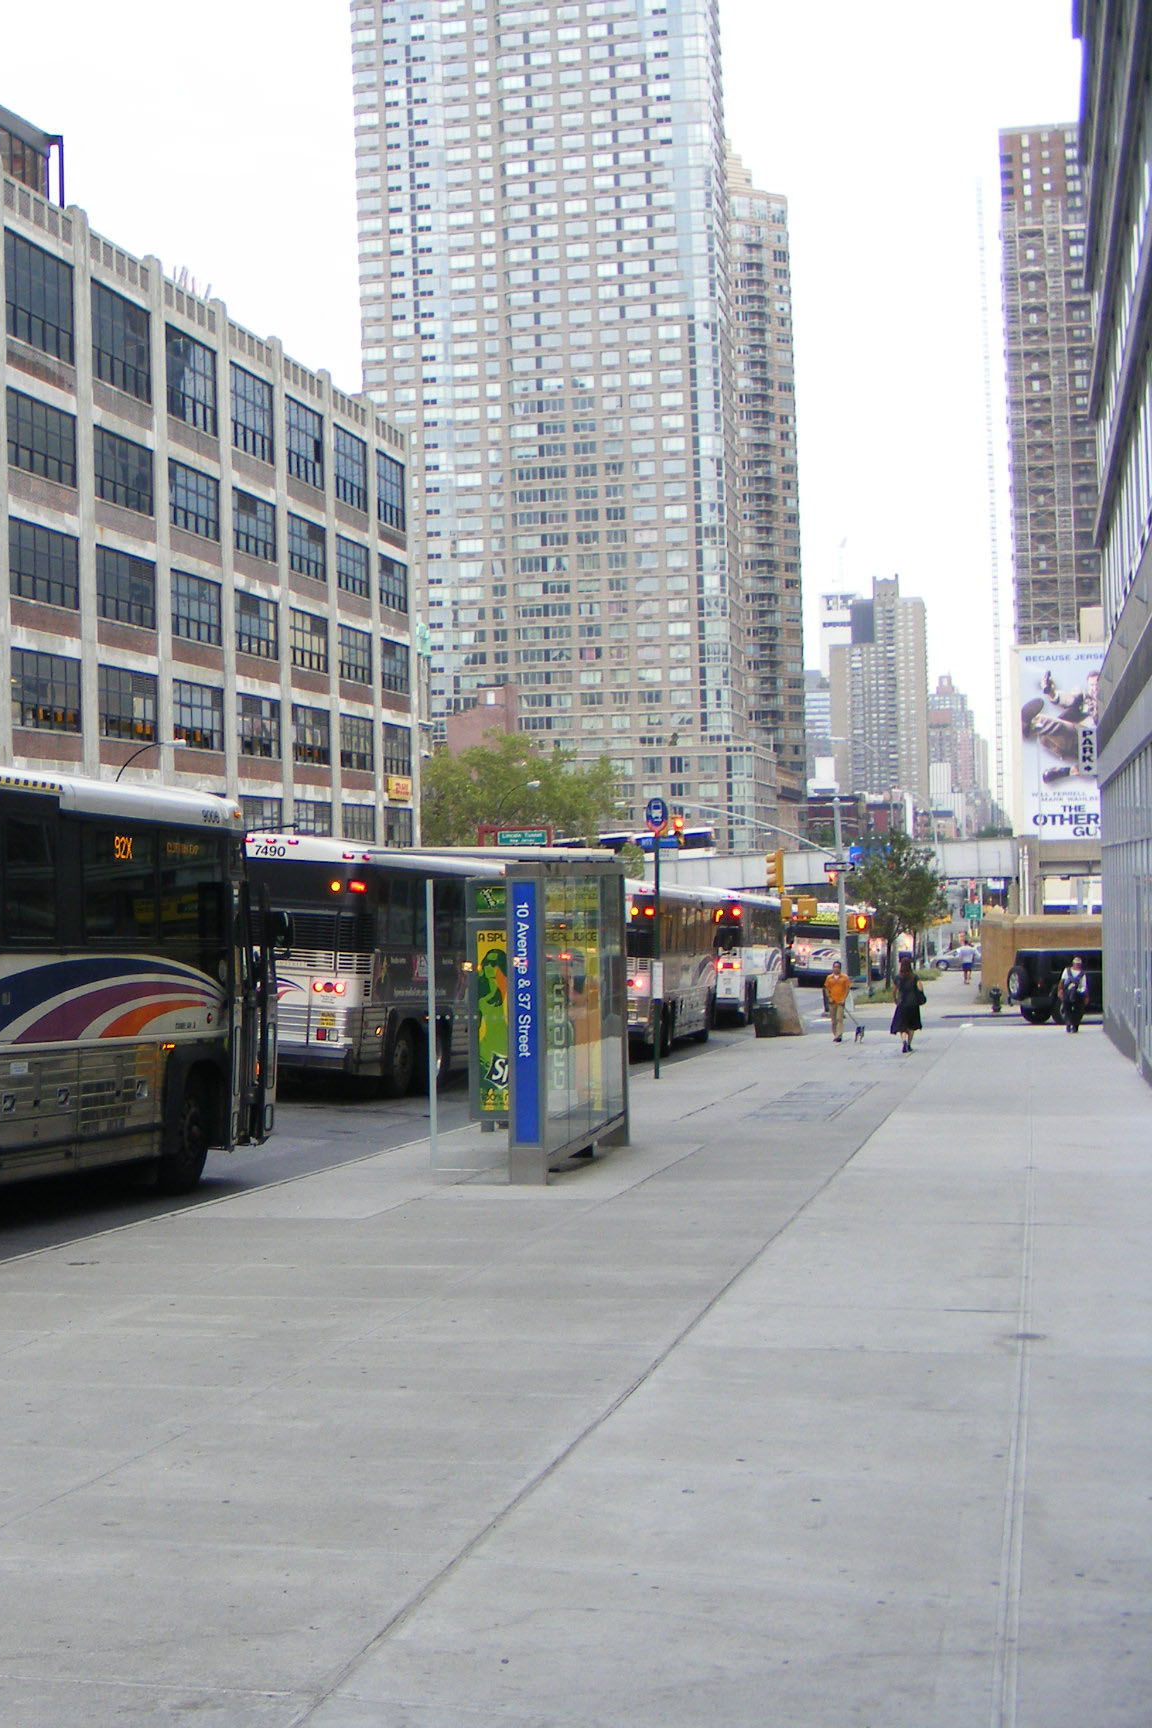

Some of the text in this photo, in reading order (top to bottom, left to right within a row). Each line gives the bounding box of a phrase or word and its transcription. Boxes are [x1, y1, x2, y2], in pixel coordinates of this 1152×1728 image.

[1025, 654, 1071, 662] BECAUSE
[1082, 730, 1094, 763] PARK
[1061, 804, 1087, 812] THE
[1032, 813, 1100, 826] OTHER
[255, 845, 286, 857] 7490
[478, 933, 485, 942] A
[516, 902, 532, 1058] 10 Avenue & 37 Street
